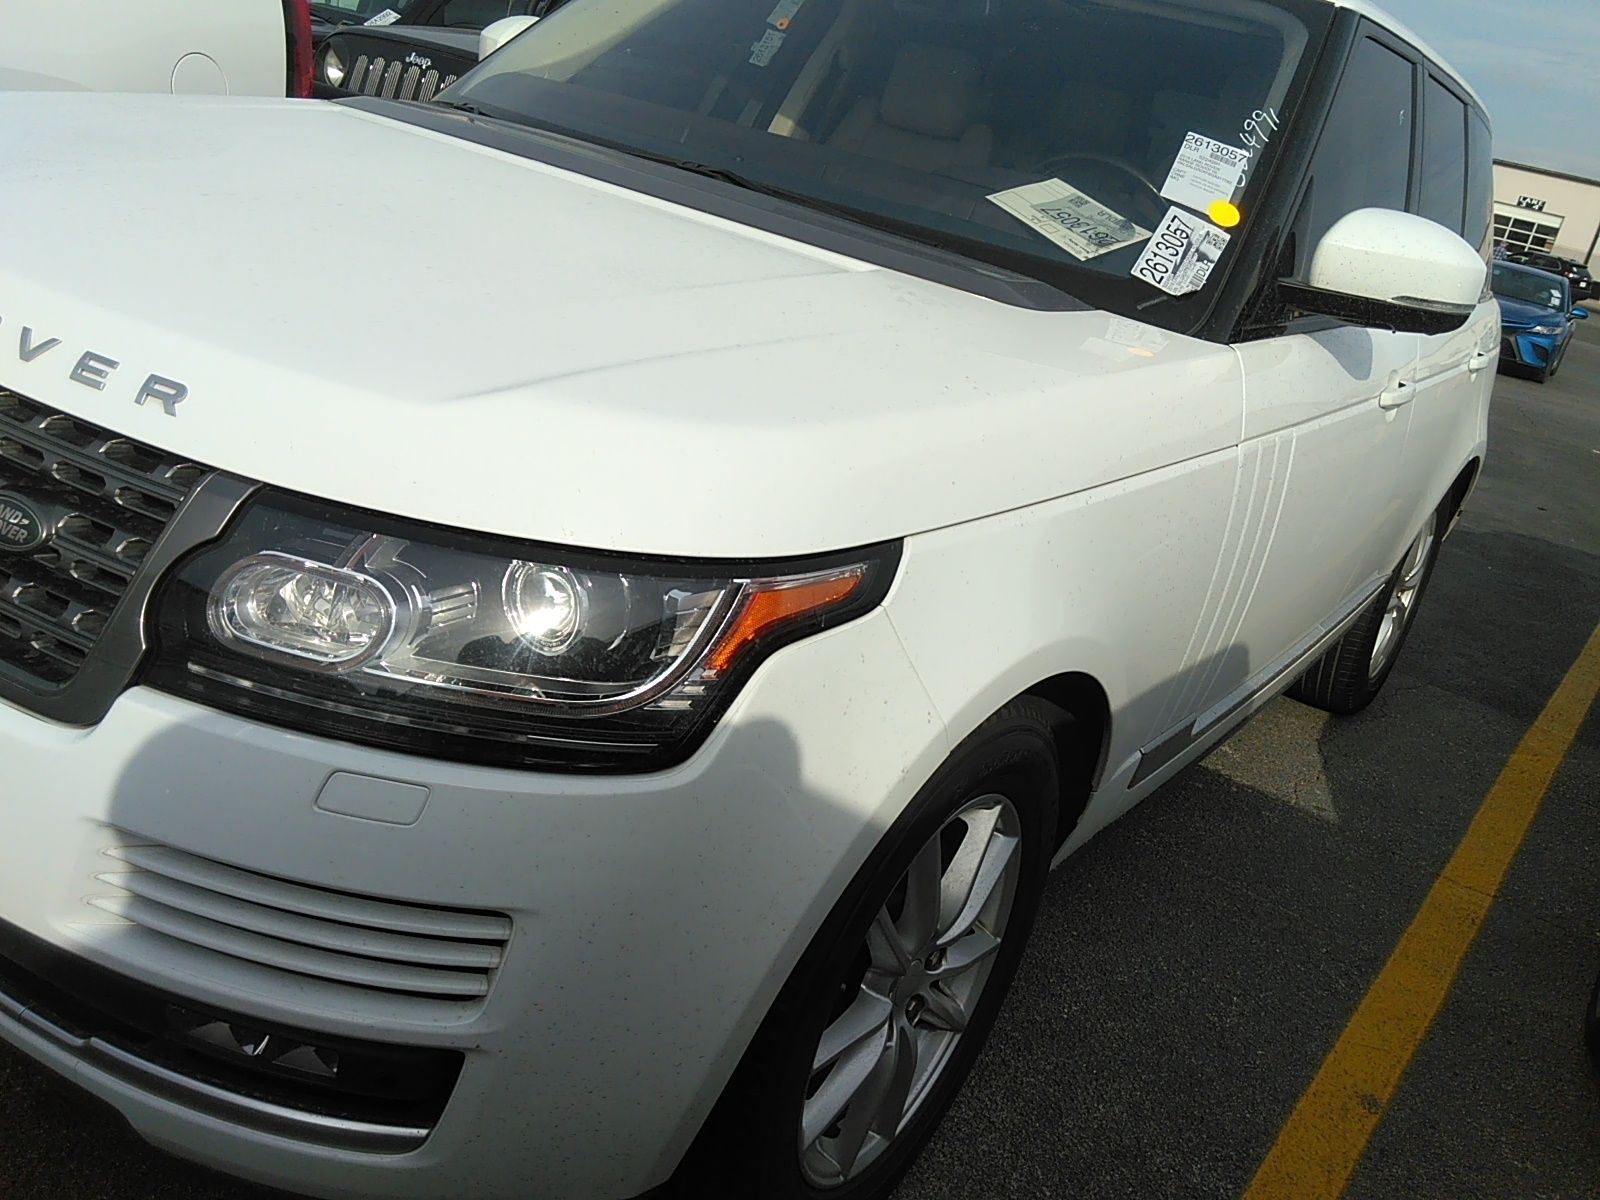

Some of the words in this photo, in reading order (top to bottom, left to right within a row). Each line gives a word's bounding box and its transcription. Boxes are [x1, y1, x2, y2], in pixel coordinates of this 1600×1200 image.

[405, 52, 431, 69] Jeep
[1184, 134, 1248, 162] 2613057
[1184, 143, 1200, 153] DLR
[1040, 208, 1121, 247] 2613057
[1139, 214, 1194, 284] 2613057
[0, 316, 189, 417] VER
